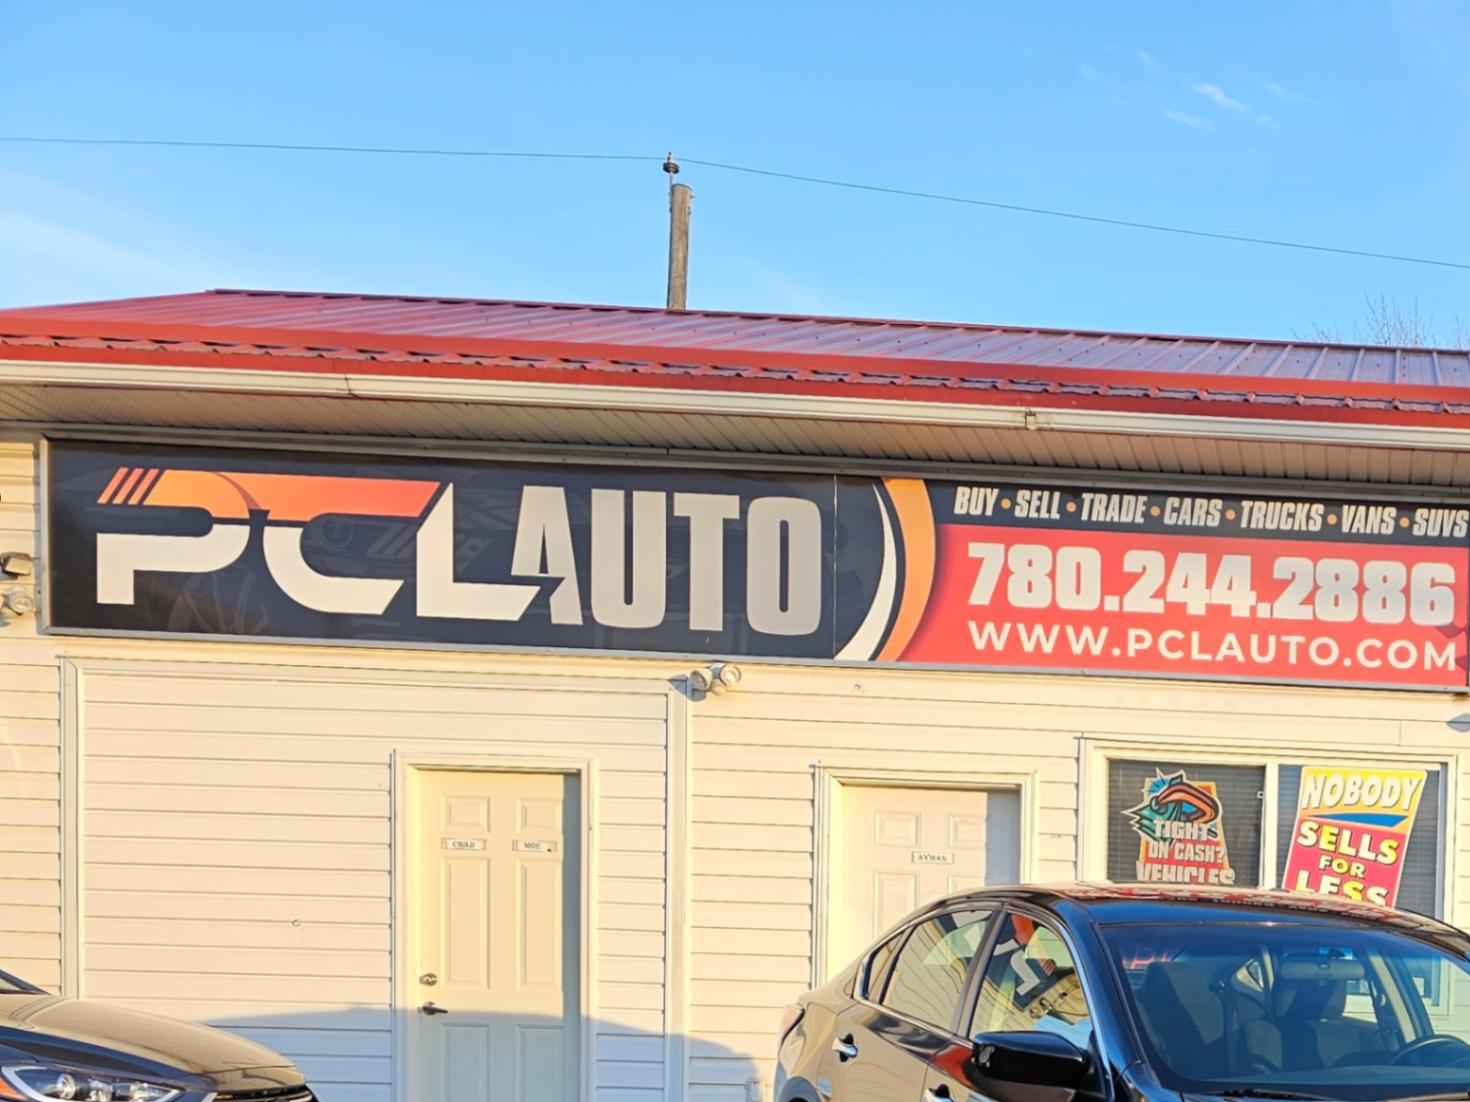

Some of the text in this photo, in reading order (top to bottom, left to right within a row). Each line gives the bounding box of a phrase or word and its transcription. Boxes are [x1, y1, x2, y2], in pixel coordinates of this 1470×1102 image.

[953, 486, 1469, 538] BUY SELL TRADE CARS TRUCKS VANS SUVS
[97, 467, 821, 636] PCL AUTO
[967, 542, 1456, 626] 780.244.2886
[968, 621, 1456, 671] WWW.PCLAUTO.COM
[1302, 774, 1421, 811] NOBODY
[1153, 819, 1209, 840] TIGHT
[1297, 821, 1399, 864] SELLS
[1148, 840, 1225, 863] ON CASH?
[1319, 856, 1366, 879] FOR
[1136, 861, 1236, 884] VEHICLES
[1296, 870, 1389, 907] LESS
